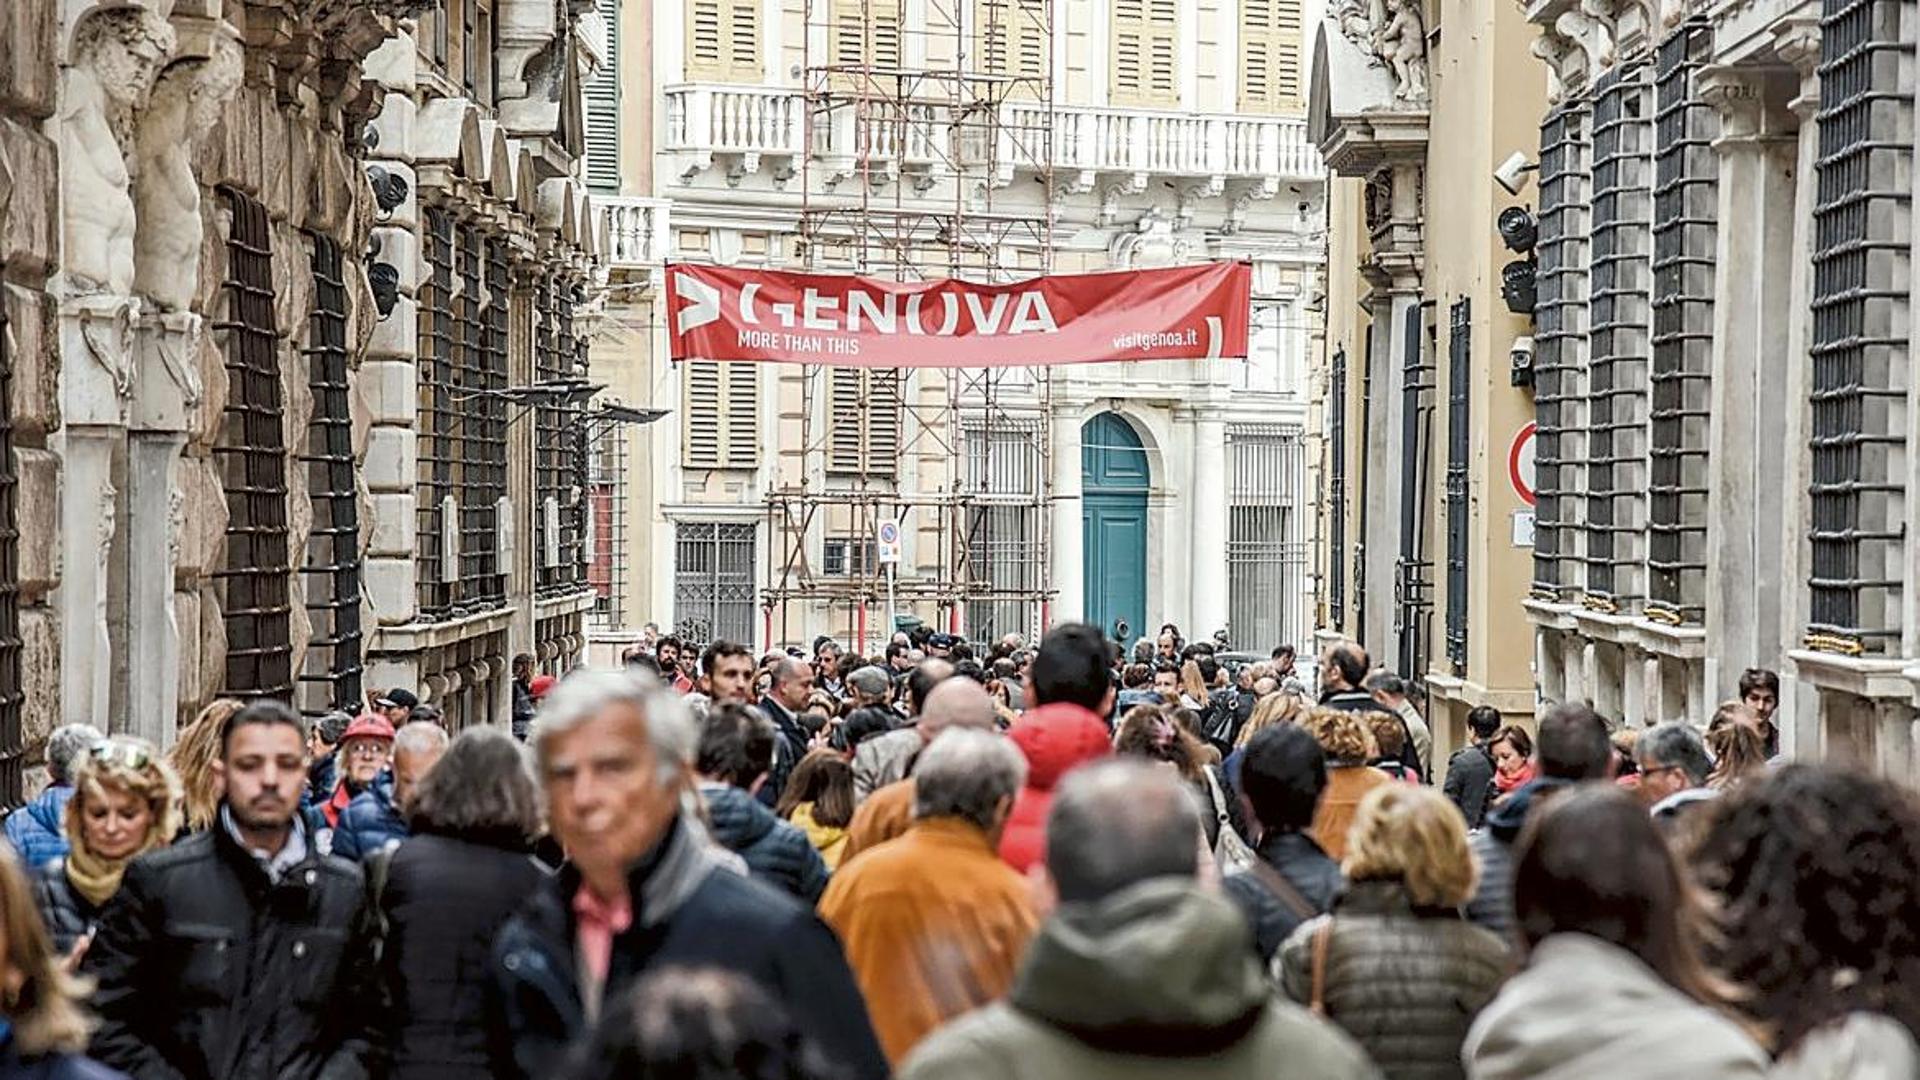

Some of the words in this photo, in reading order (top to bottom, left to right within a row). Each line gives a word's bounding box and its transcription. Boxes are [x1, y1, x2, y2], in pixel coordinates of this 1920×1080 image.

[739, 282, 1059, 335] GENOVA
[737, 330, 779, 349] MORE
[783, 334, 822, 352] THAN
[826, 337, 860, 355] THIS
[1112, 328, 1198, 350] visitgenoa.it
